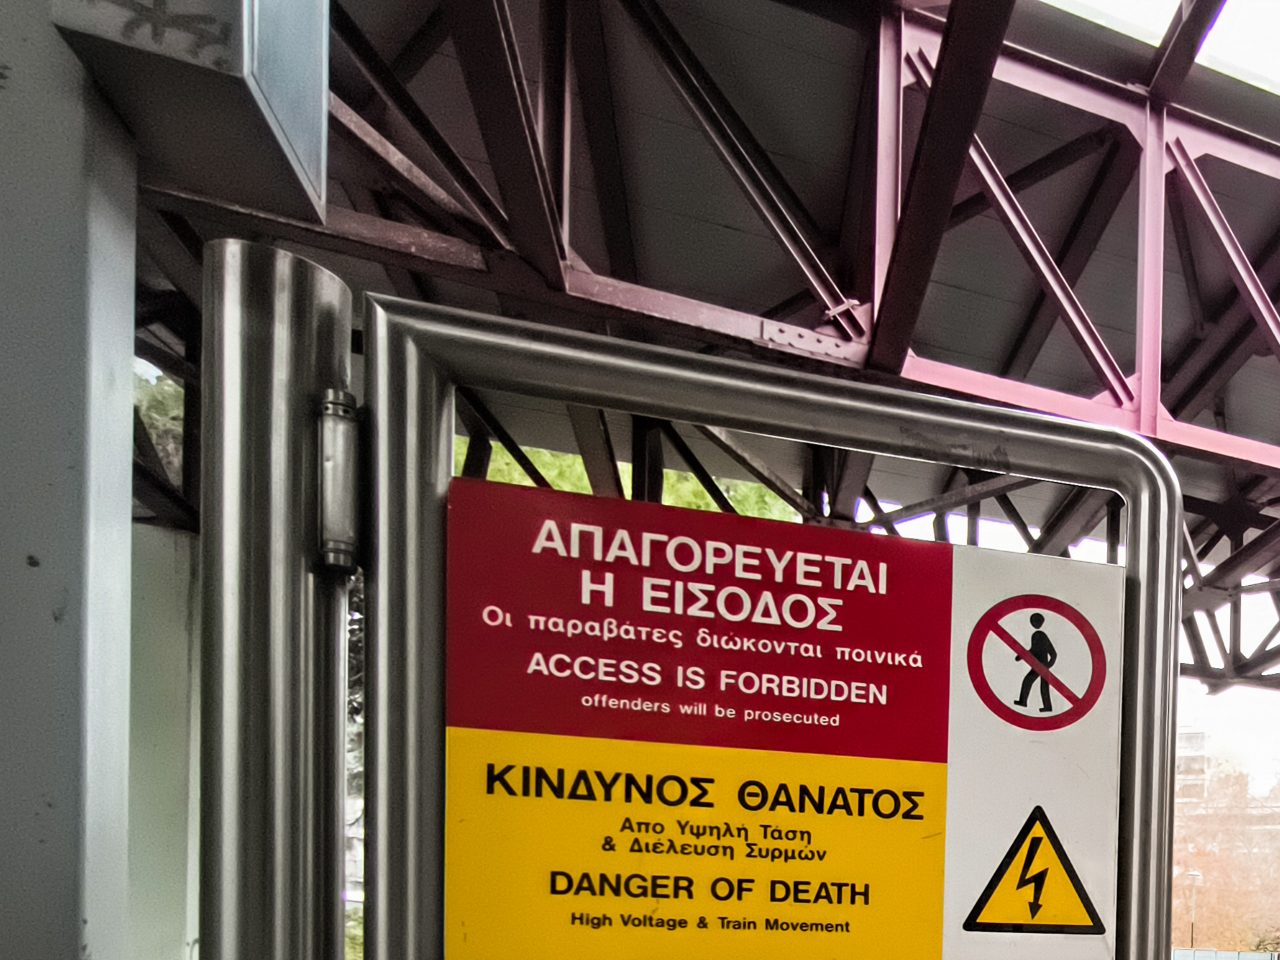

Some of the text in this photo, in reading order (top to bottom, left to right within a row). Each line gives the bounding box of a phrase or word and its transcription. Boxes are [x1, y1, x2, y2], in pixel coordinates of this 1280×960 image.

[531, 519, 888, 595] ΑΠΑΓΟΡΕΥΕΤΑΙ
[581, 569, 844, 632] Η ΕΙΣΟΔΟΣ
[482, 605, 923, 668] Οι παραβάτες διώκονται ποινικά
[526, 652, 888, 705] ACCESS IS FORBIDDEN
[580, 693, 840, 727] offenders will be prosecuted
[485, 762, 925, 821] ΚΙΝΔΥΝΟΣ ΘΑΝΑΤΟΣ
[601, 835, 827, 863] & Διέλευση Συρμών
[759, 824, 812, 846] Τάση
[549, 870, 870, 906] DANGER OF DEATH
[570, 912, 850, 933] High Voltage & Train Movement
